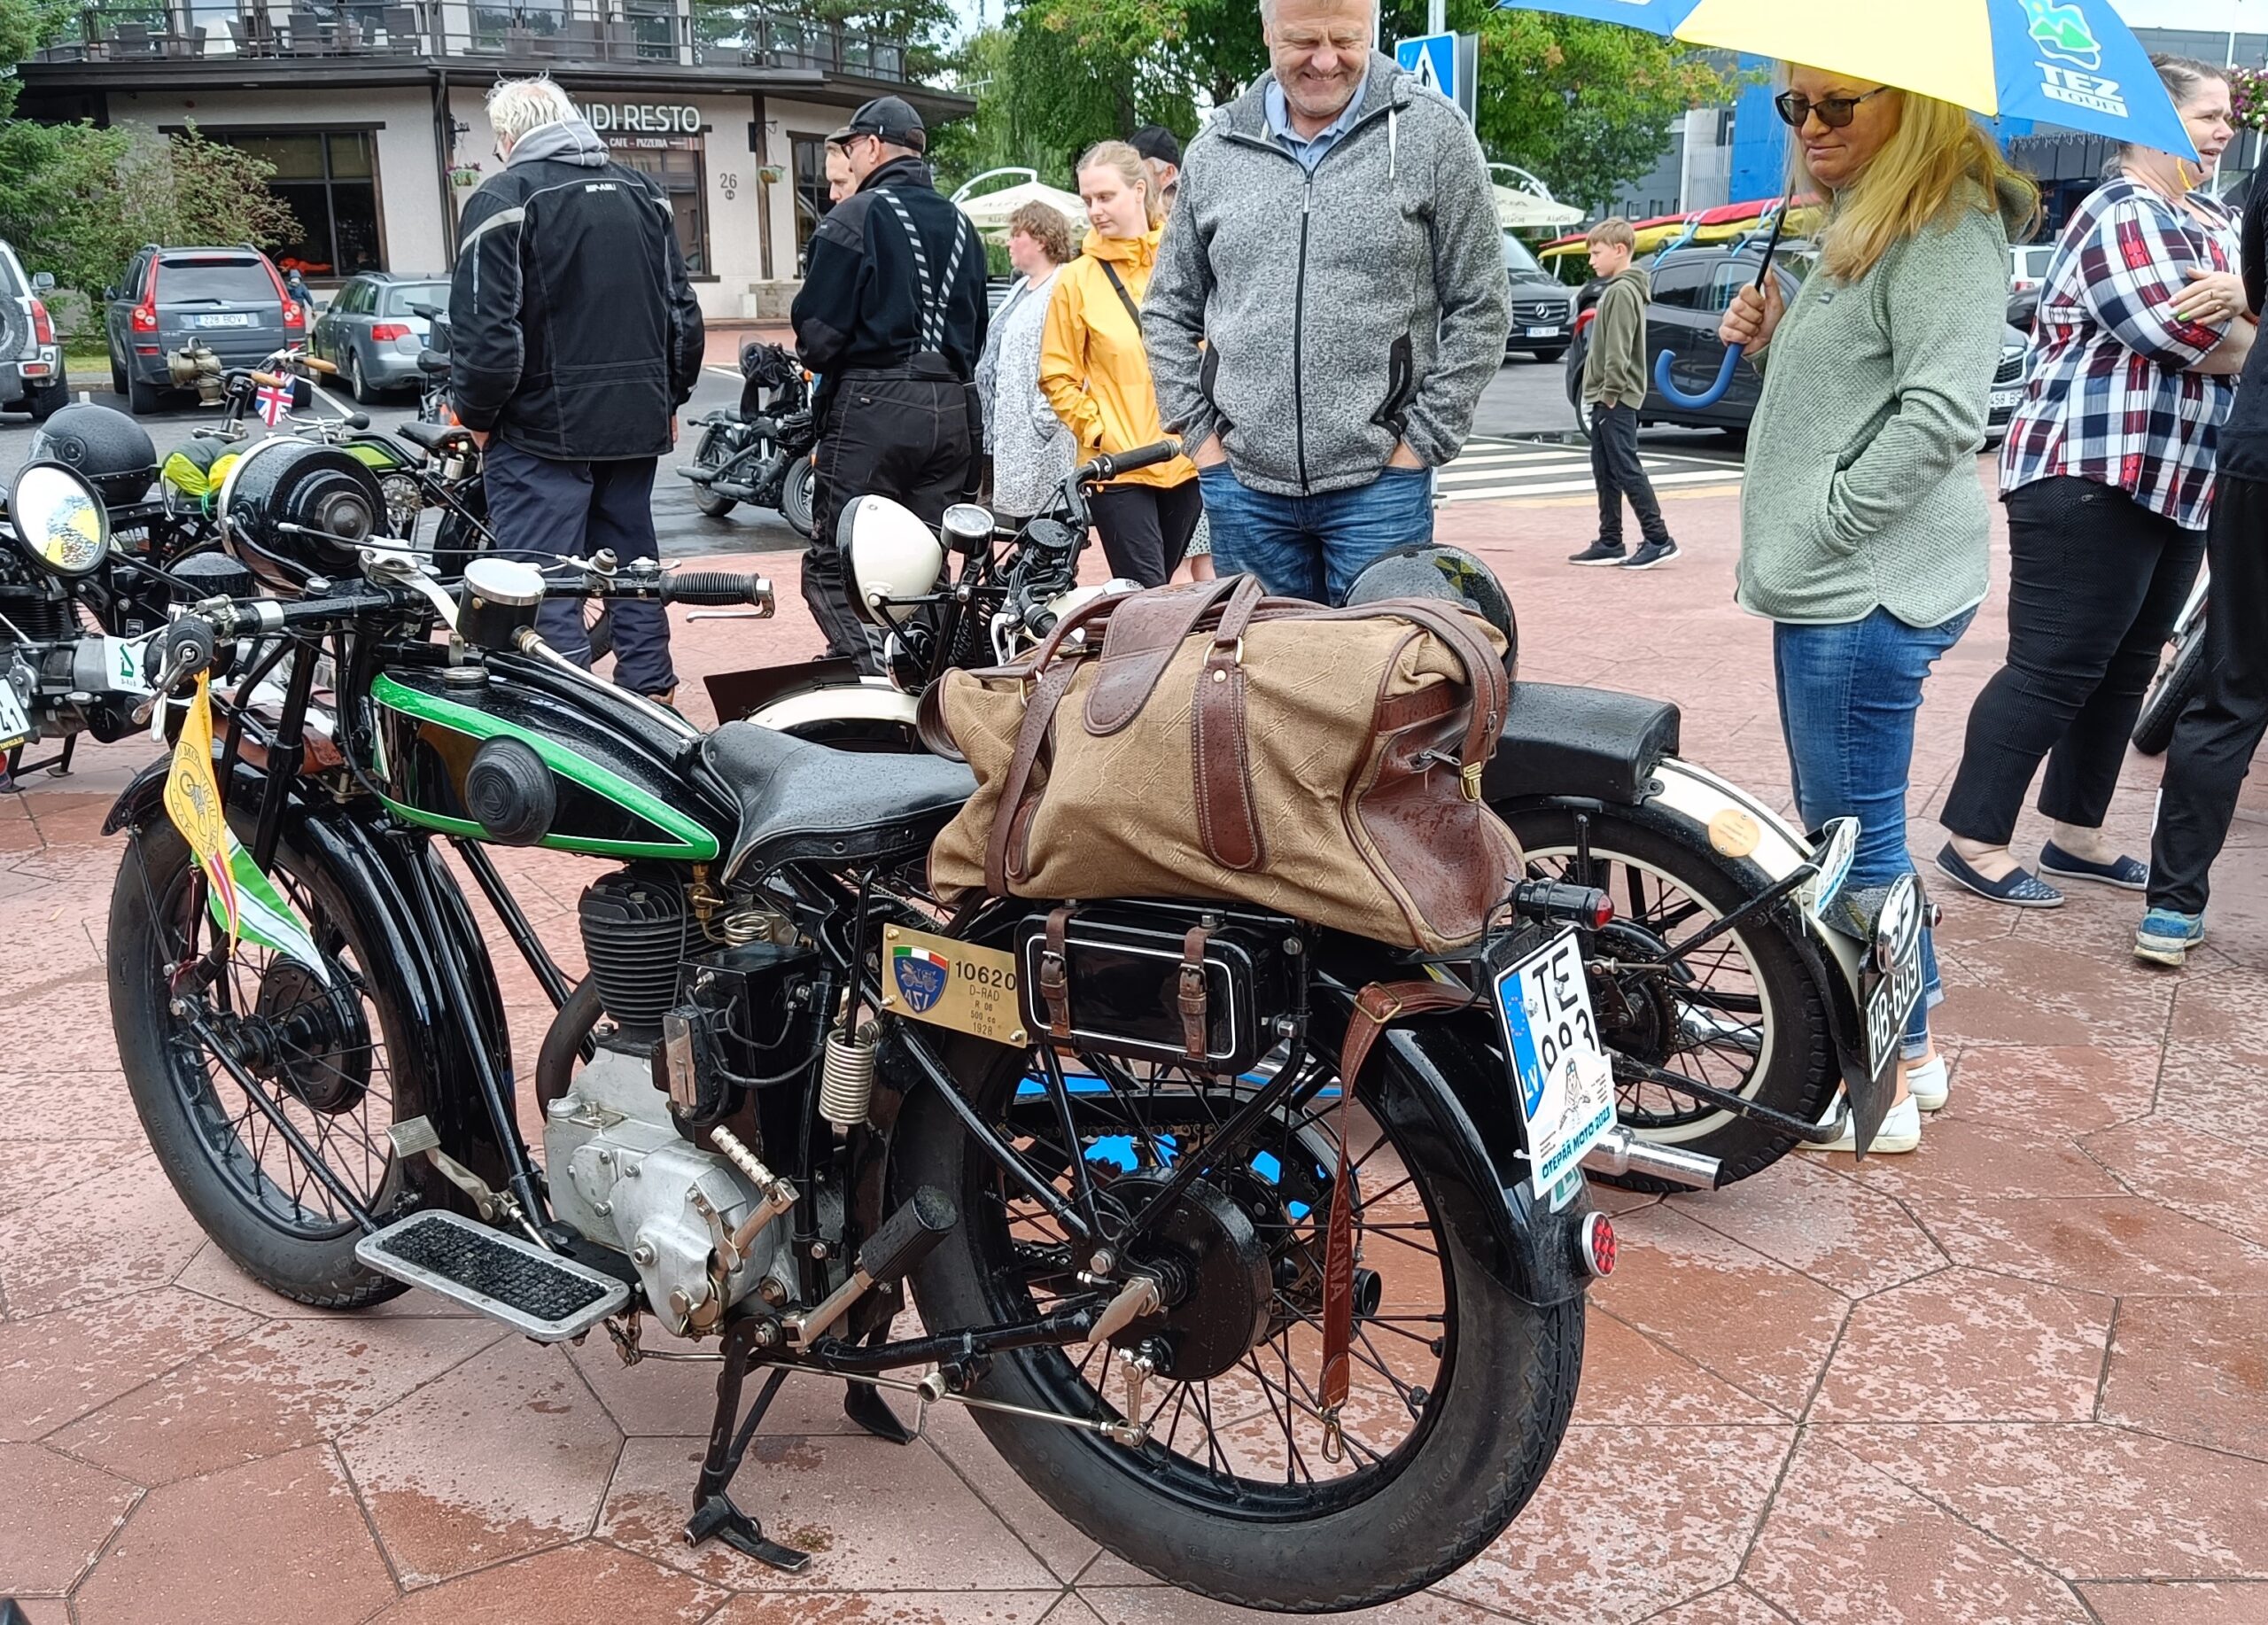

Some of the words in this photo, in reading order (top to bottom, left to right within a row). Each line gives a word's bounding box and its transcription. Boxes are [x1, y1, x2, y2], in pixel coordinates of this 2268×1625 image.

[2034, 60, 2124, 103] TEZ
[2050, 89, 2122, 114] TOUR
[623, 104, 701, 132] RESTO
[609, 137, 628, 148] CAFE
[719, 173, 737, 189] 26
[955, 960, 1016, 991] 10620
[1532, 946, 1579, 1023] TE
[904, 989, 929, 1012] ASI
[969, 984, 1000, 1001] D-RAD
[970, 1011, 983, 1021] 500
[973, 1022, 993, 1036] 1928
[1521, 1058, 1540, 1100] LV
[1542, 1139, 1573, 1179] OTEPÄÄ
[1573, 1124, 1595, 1152] MOTO
[1595, 1106, 1611, 1131] 2023
[1330, 1183, 1348, 1302] KATANA
